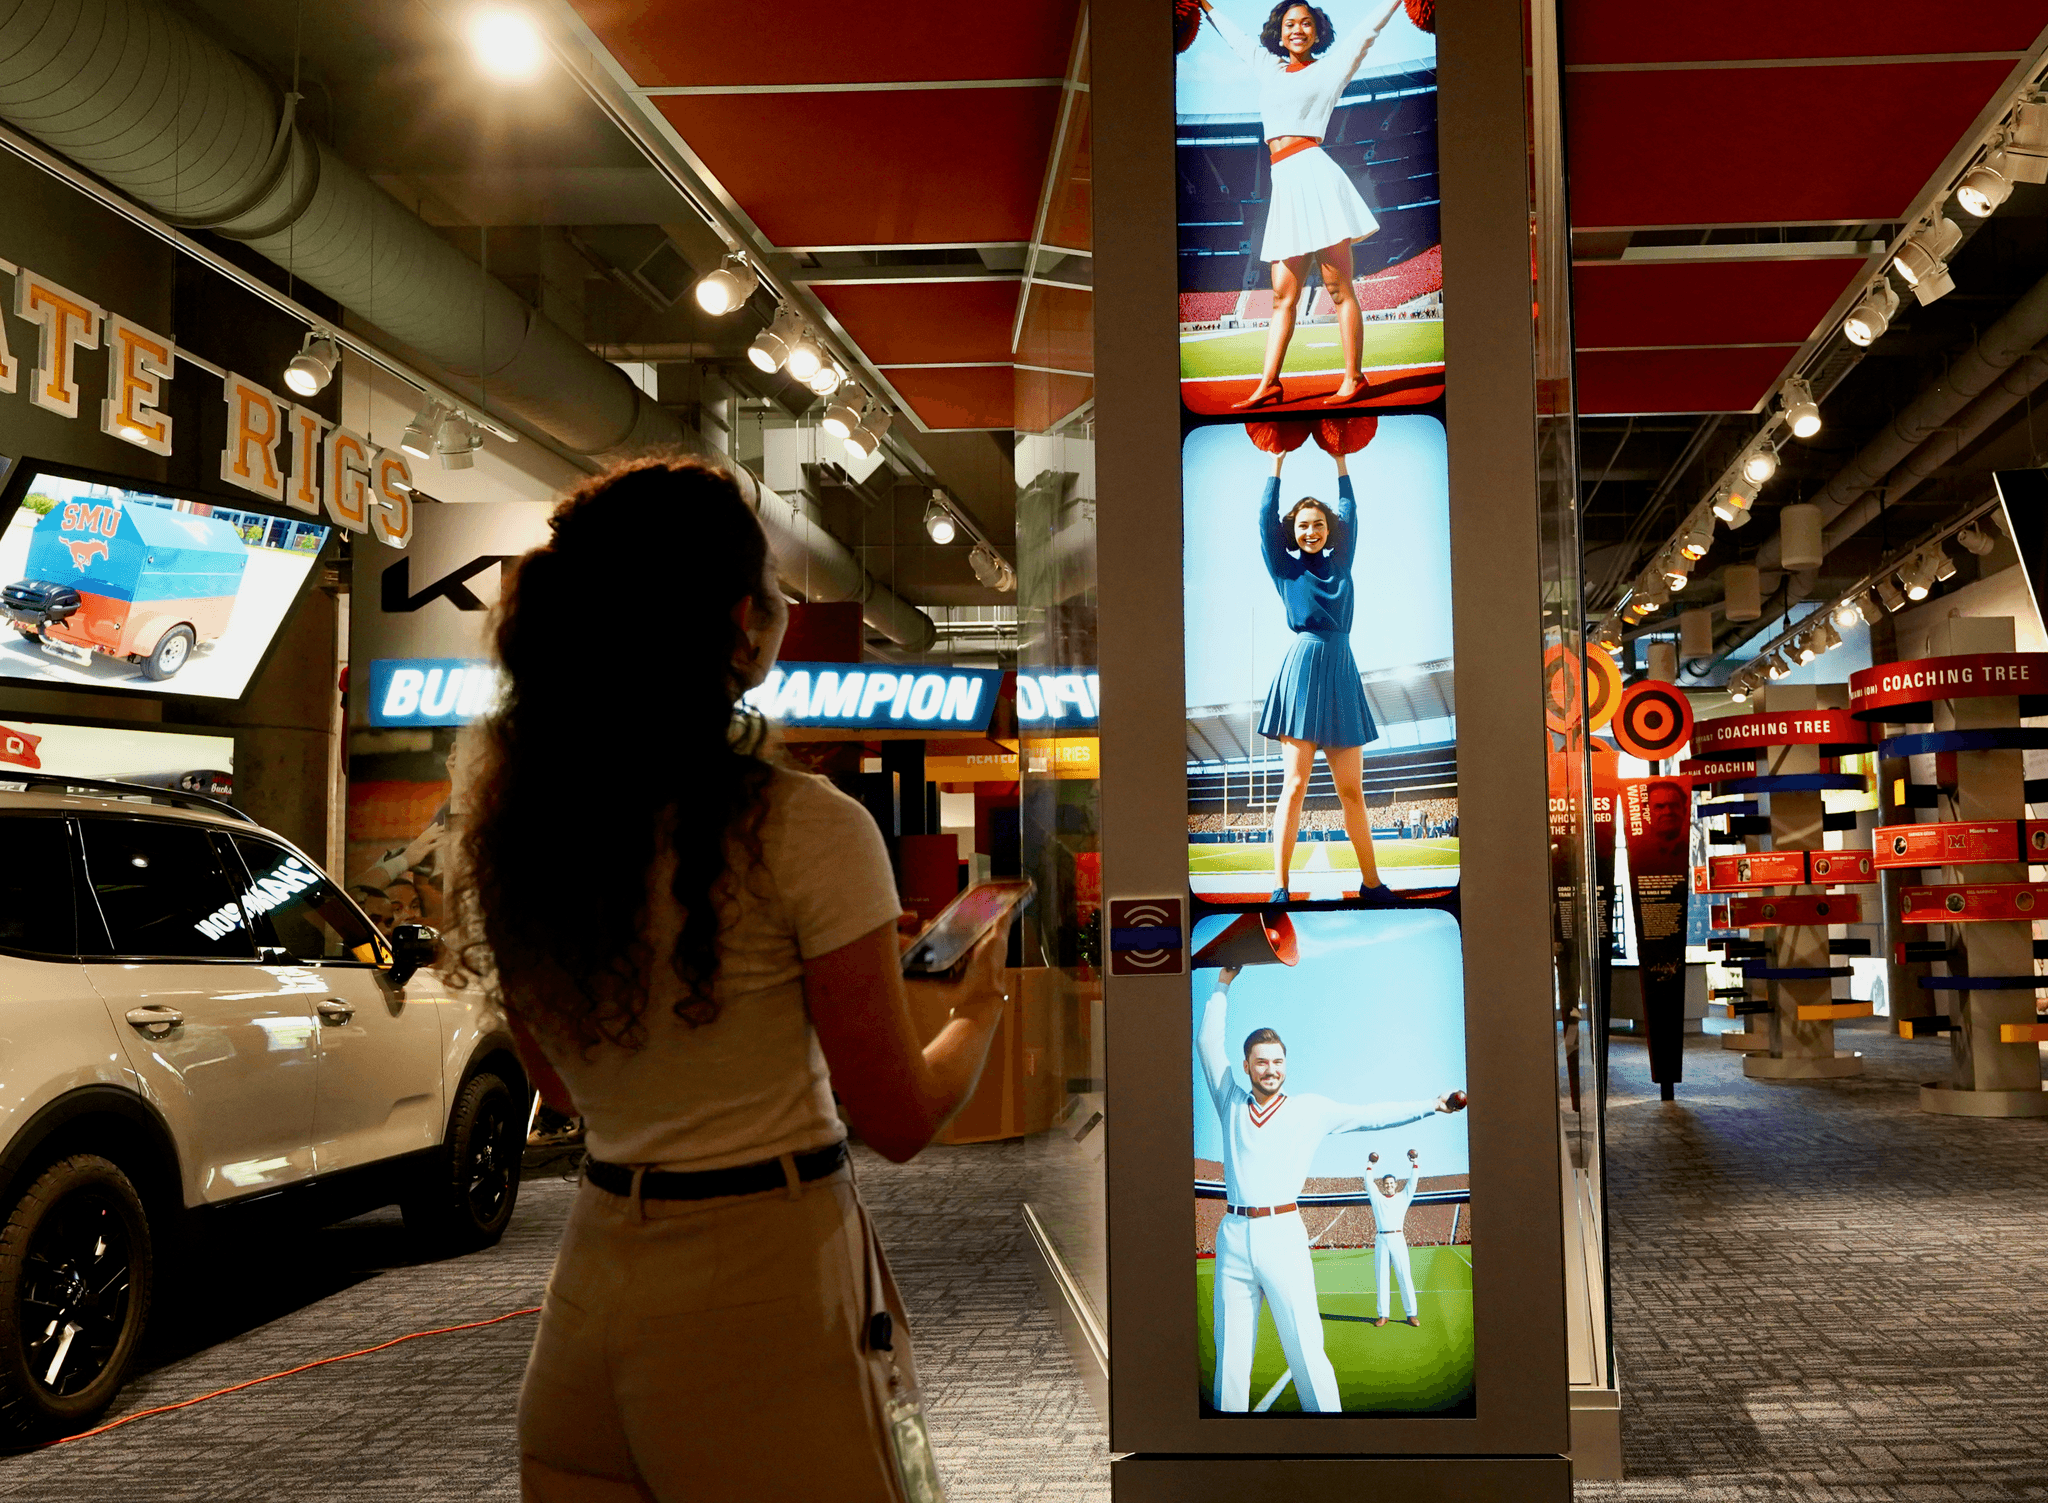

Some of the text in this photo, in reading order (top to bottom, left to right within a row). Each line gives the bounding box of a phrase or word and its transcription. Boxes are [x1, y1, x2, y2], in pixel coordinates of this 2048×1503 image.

[0, 267, 413, 549] TE RIGS
[61, 503, 121, 538] SMU
[744, 670, 982, 720] HAMPION
[1883, 667, 1973, 692] COACHING
[1982, 665, 2030, 682] TREE
[1717, 722, 1788, 740] COACHING
[1794, 720, 1831, 733] TREE
[1626, 784, 1644, 837] WARNER
[1639, 784, 1649, 803] GLEN
